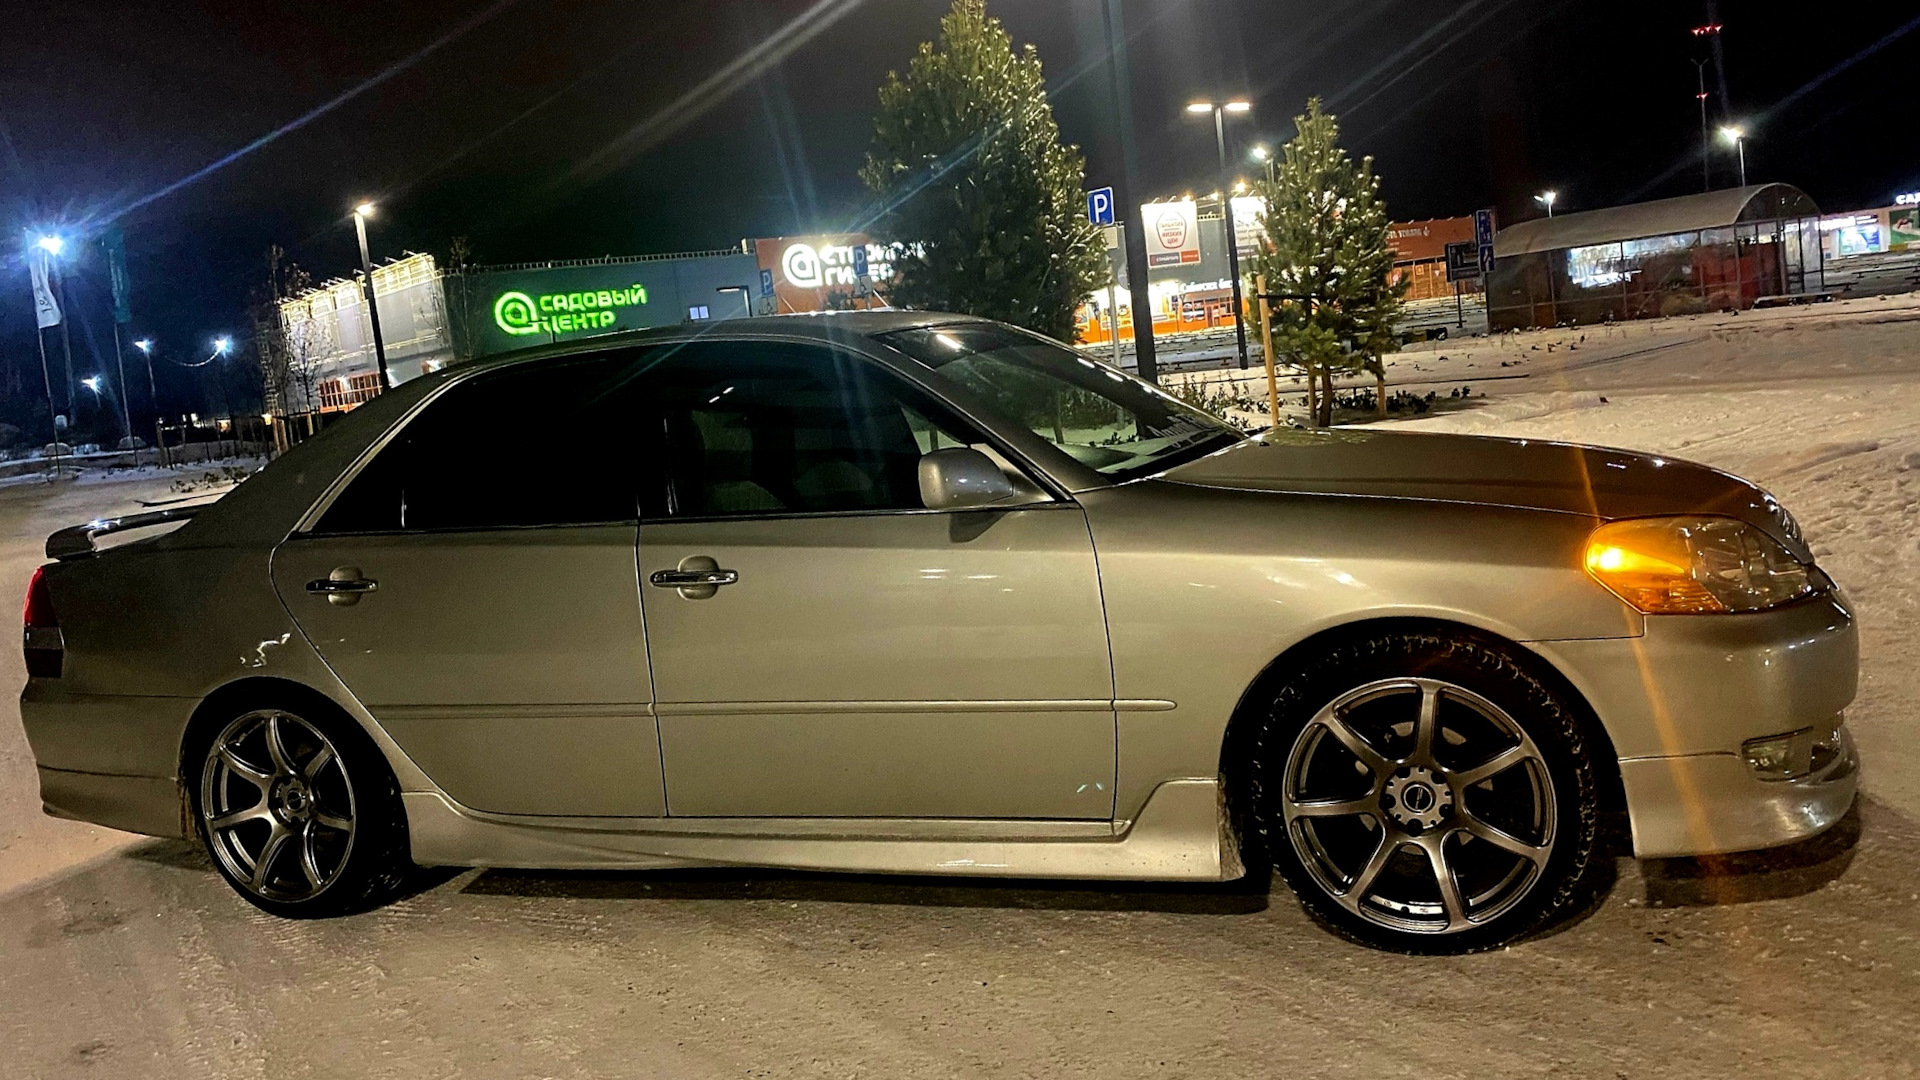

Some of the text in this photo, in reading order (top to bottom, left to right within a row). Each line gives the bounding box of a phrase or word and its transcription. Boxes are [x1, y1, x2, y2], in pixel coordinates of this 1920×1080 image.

[1093, 193, 1108, 223] P
[539, 284, 648, 312] САДОВЫЙ
[542, 310, 617, 334] ЦЕНТР
